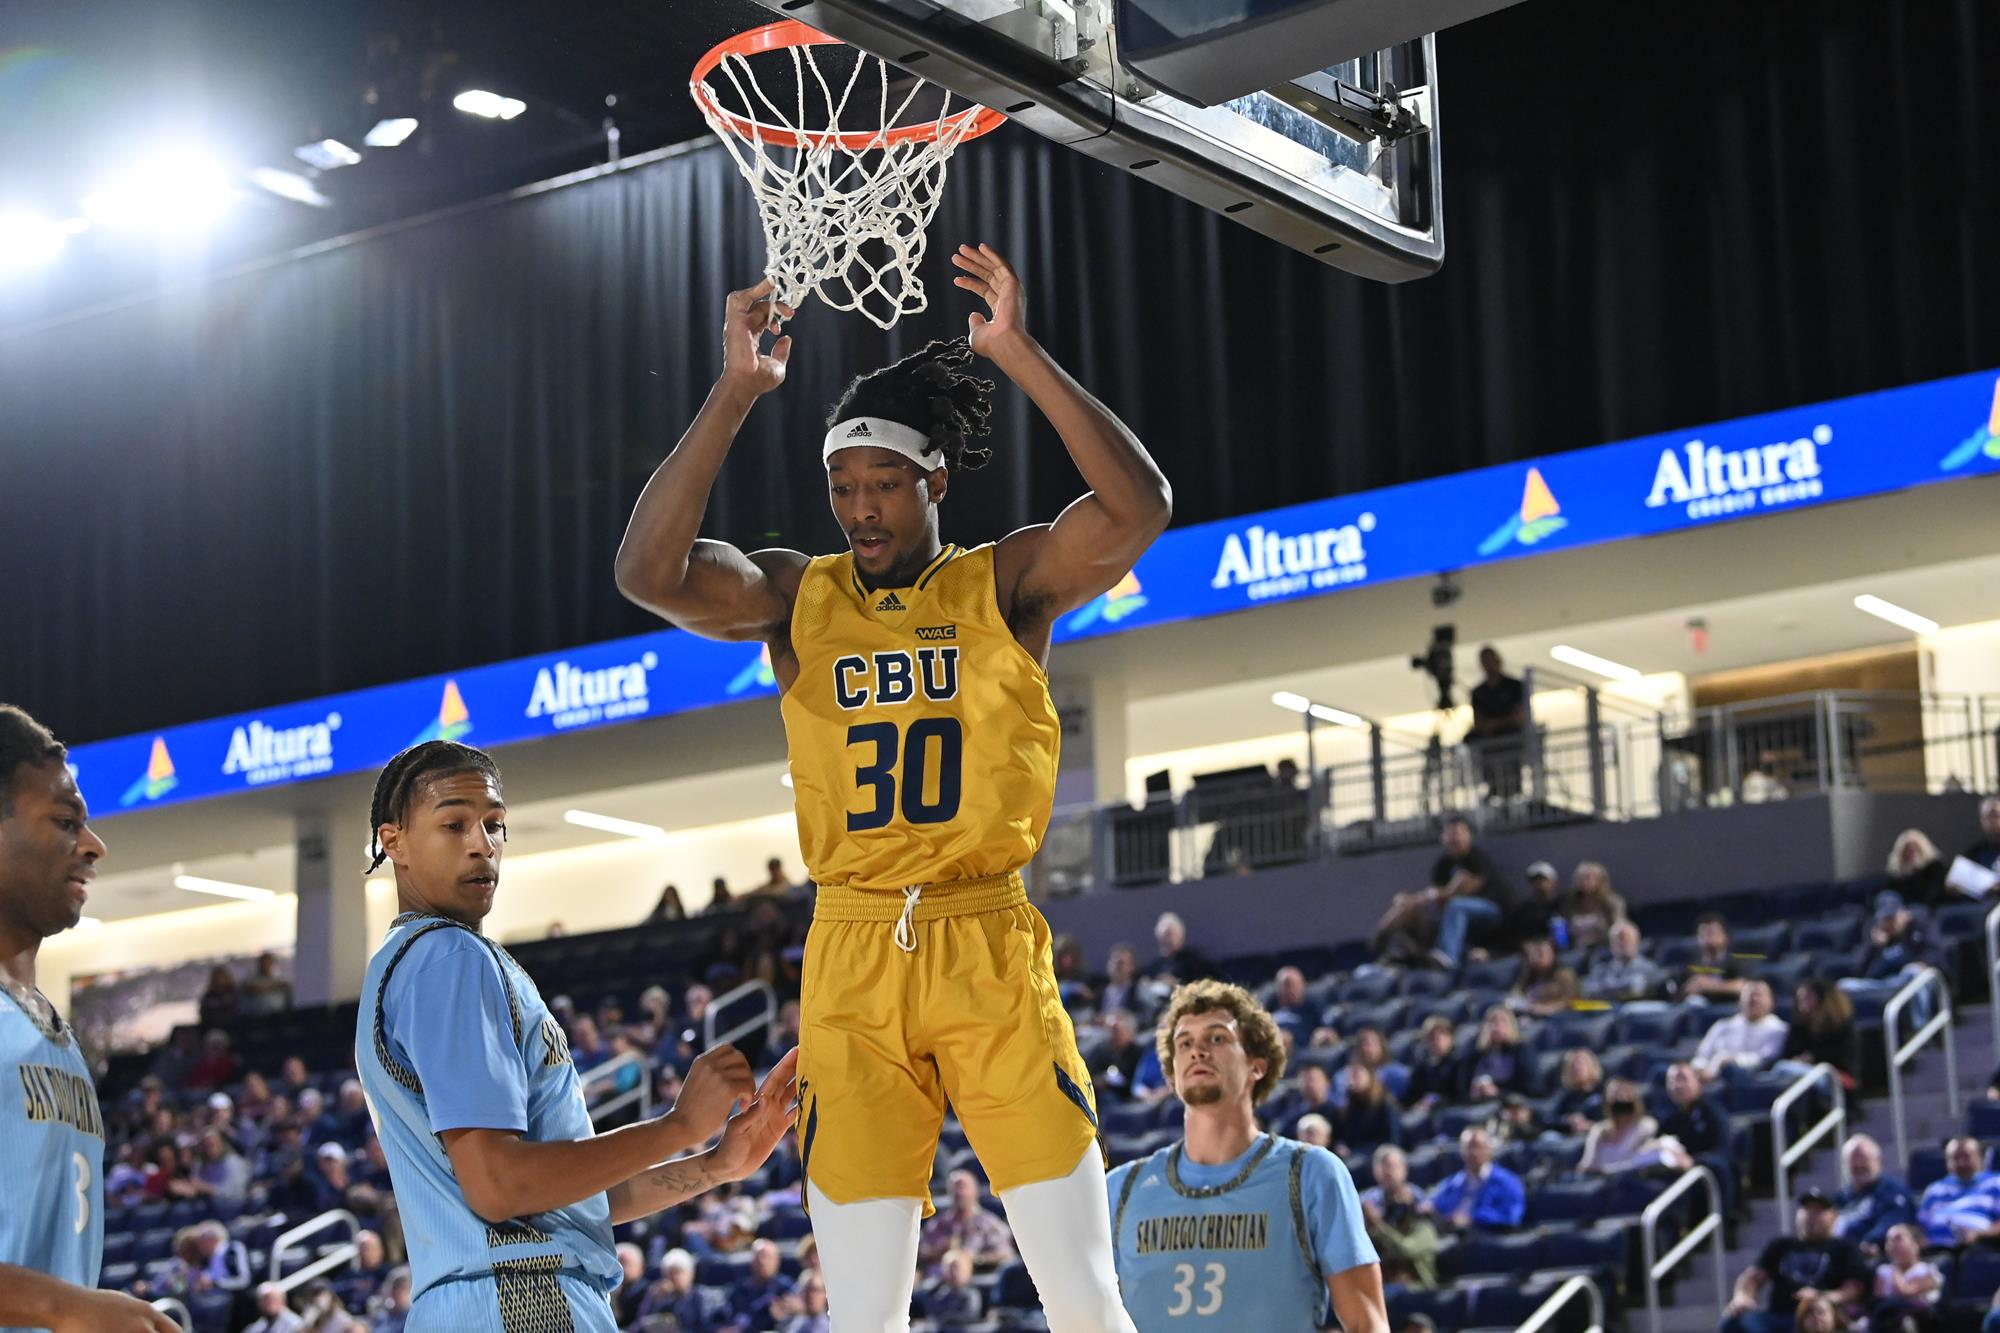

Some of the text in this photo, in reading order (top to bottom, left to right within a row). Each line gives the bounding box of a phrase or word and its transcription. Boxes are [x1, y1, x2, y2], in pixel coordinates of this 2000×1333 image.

[846, 430, 872, 439] adidas
[1645, 438, 1822, 508] Altura
[1211, 524, 1366, 589] Altura
[875, 603, 906, 611] adidas
[916, 626, 955, 639] WAC
[525, 661, 648, 718] Altura
[833, 646, 960, 711] CBU
[222, 720, 333, 775] Altura
[847, 717, 962, 832] 30
[1137, 1212, 1268, 1254] SAN DIEGO CHRISTIAN
[1168, 1262, 1227, 1317] 33
